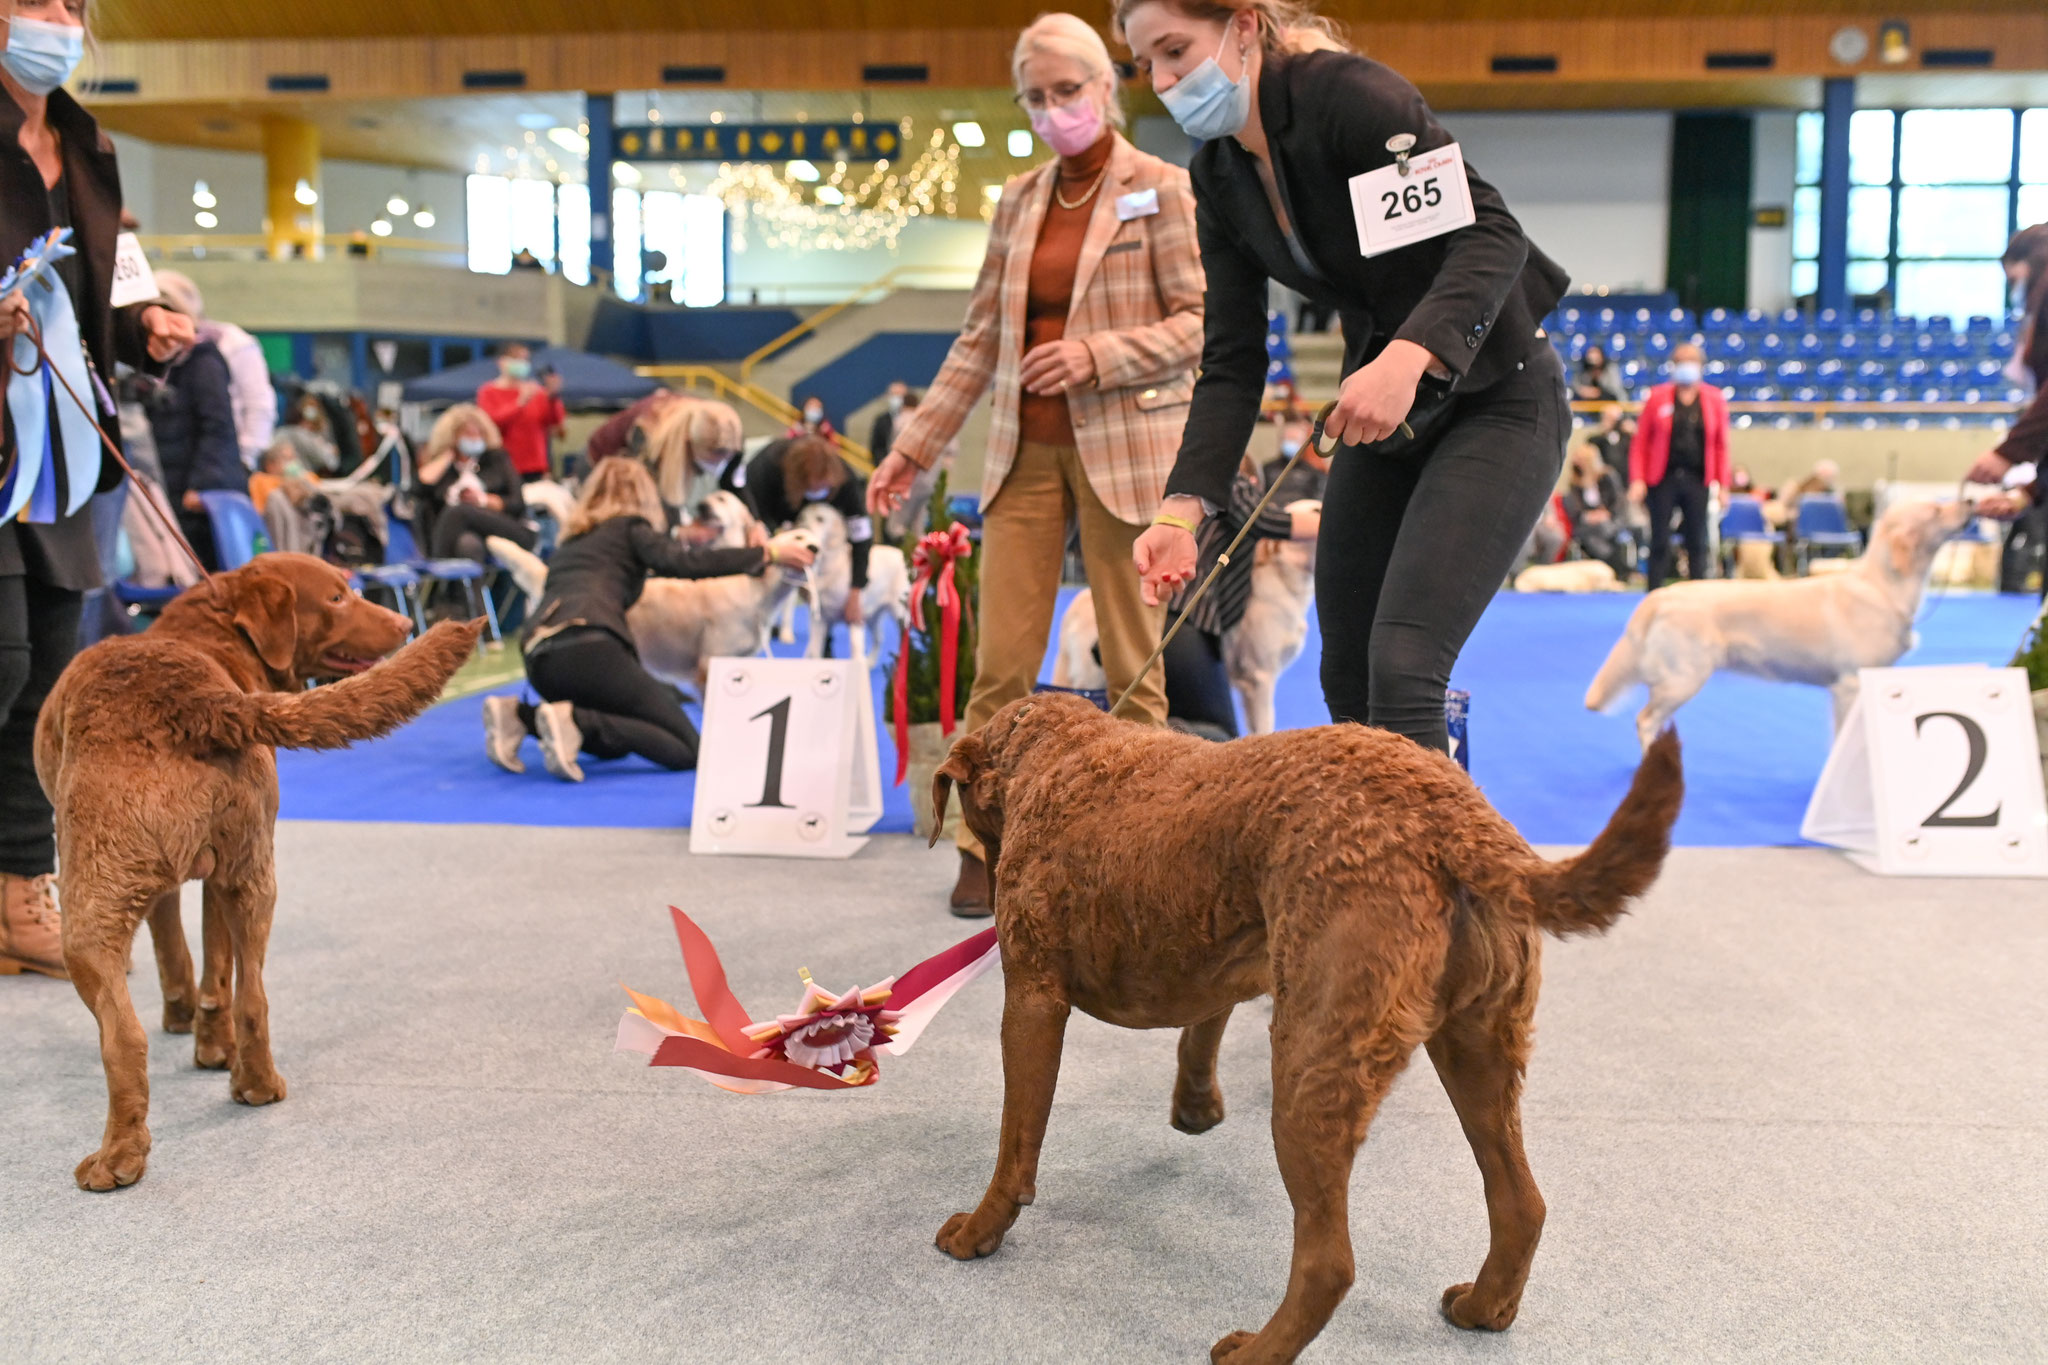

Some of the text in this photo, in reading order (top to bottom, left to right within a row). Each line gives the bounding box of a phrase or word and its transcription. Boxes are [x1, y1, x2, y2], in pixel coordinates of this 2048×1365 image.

[1382, 178, 1442, 220] 265
[743, 695, 797, 809] 1
[1914, 711, 2003, 828] 2
